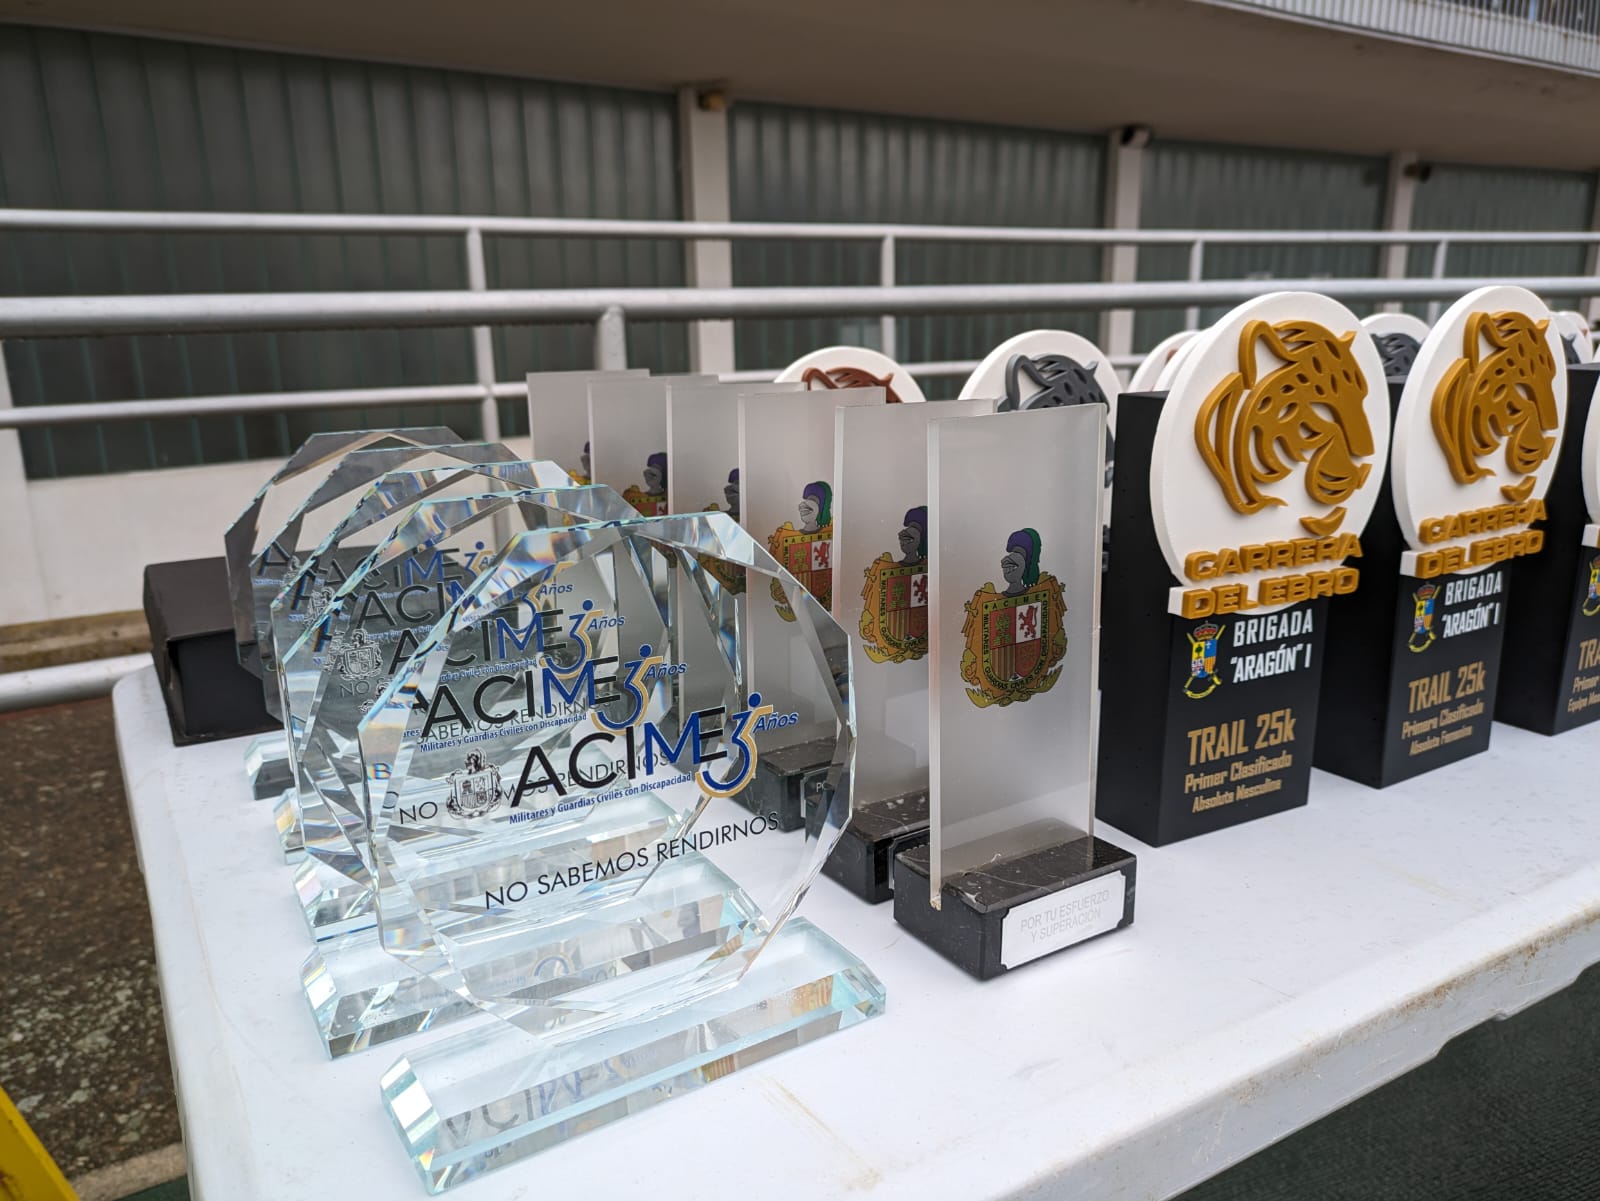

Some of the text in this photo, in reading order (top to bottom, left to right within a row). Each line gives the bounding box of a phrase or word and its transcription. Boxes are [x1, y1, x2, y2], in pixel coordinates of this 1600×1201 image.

[1418, 499, 1547, 545] CARRERA
[889, 567, 924, 577] ACIM
[1184, 532, 1364, 581] CARRERA
[1416, 530, 1545, 579] DEL EBRO
[539, 583, 574, 597] Años
[992, 593, 1041, 610] ACIME
[1182, 567, 1360, 619] DEL EBRO
[1444, 571, 1503, 606] BRIGADA
[587, 615, 626, 631] Años
[1233, 608, 1313, 647] BRIGADA
[421, 656, 621, 738] ACIME
[645, 662, 688, 681] Años
[1408, 661, 1486, 714] TRAIL 25k
[420, 738, 456, 752] Militares
[463, 731, 498, 744] Guardias
[499, 725, 524, 737] Civiles
[525, 722, 538, 732] con
[540, 714, 587, 730] Discapacidad
[1187, 708, 1297, 767] TRAIL 25k
[510, 705, 728, 808] ACIME
[752, 711, 799, 734] Años
[1184, 750, 1293, 794] Primer Clasificado
[400, 801, 438, 824] NO
[509, 807, 550, 825] Militares
[557, 797, 596, 814] Guardias
[596, 790, 623, 806] Civiles
[624, 787, 639, 797] con
[640, 772, 692, 792] Discapacidad
[485, 812, 779, 909] NO SABEMOS RENDIRNOS
[1020, 890, 1110, 932] POR TU ESFUERZO
[1030, 930, 1037, 943] Y
